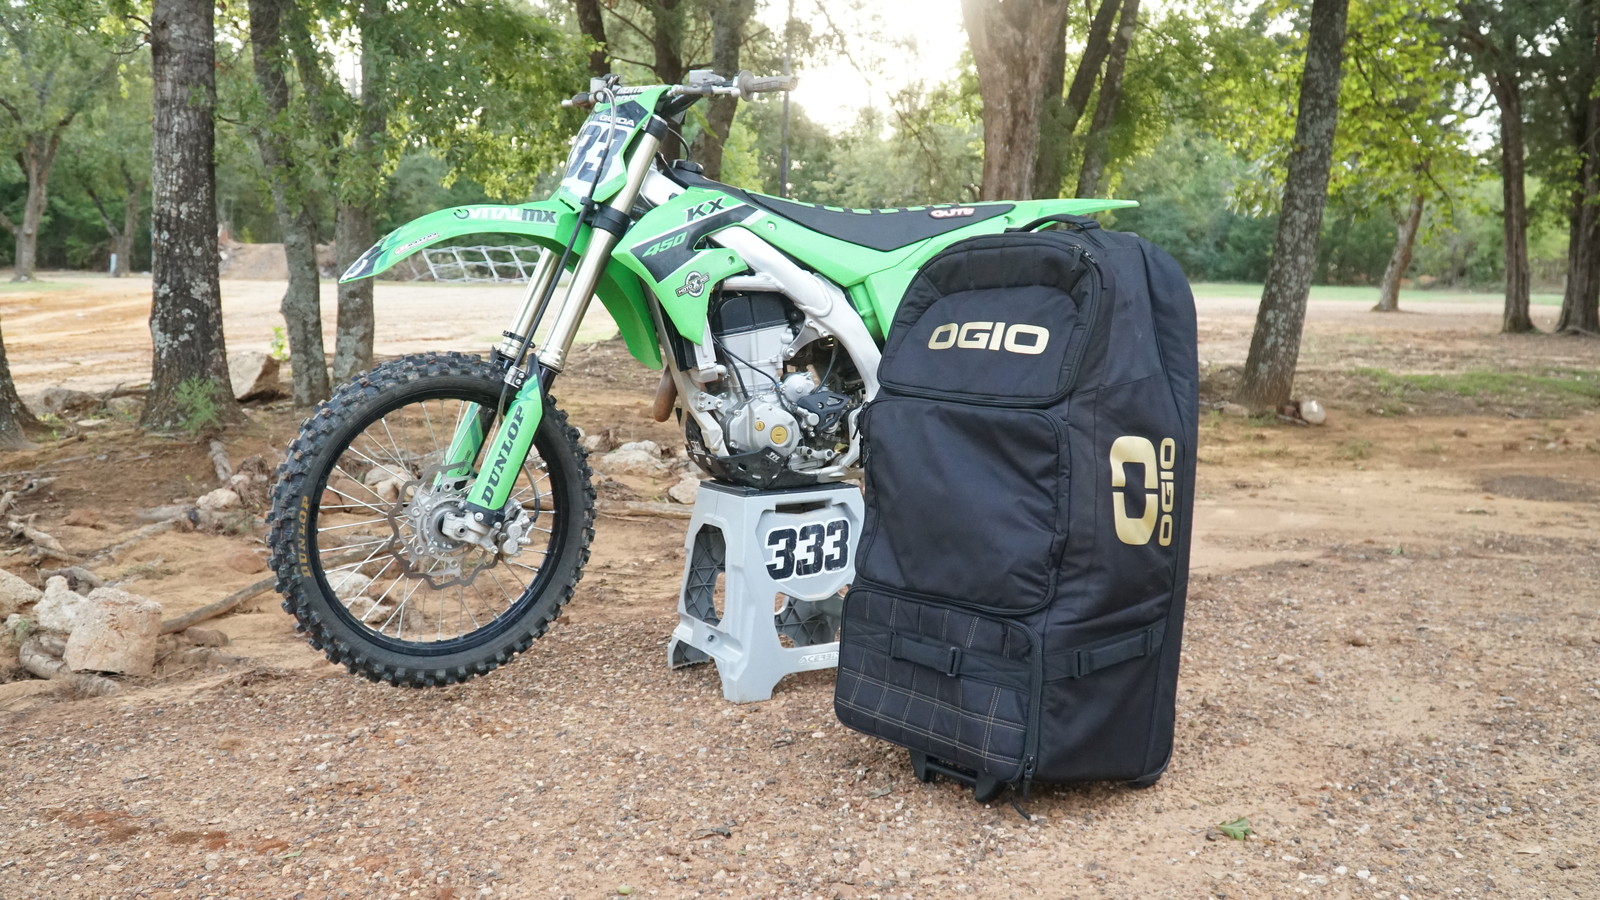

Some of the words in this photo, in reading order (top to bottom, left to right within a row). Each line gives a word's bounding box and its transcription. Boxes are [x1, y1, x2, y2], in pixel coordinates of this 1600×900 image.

[684, 196, 726, 223] KX
[641, 231, 688, 258] 450
[928, 321, 1050, 355] OGIO
[481, 405, 525, 507] DUNLOP
[1158, 437, 1176, 547] OGIO
[298, 495, 312, 578] DUNLOP
[766, 519, 850, 581] 333
